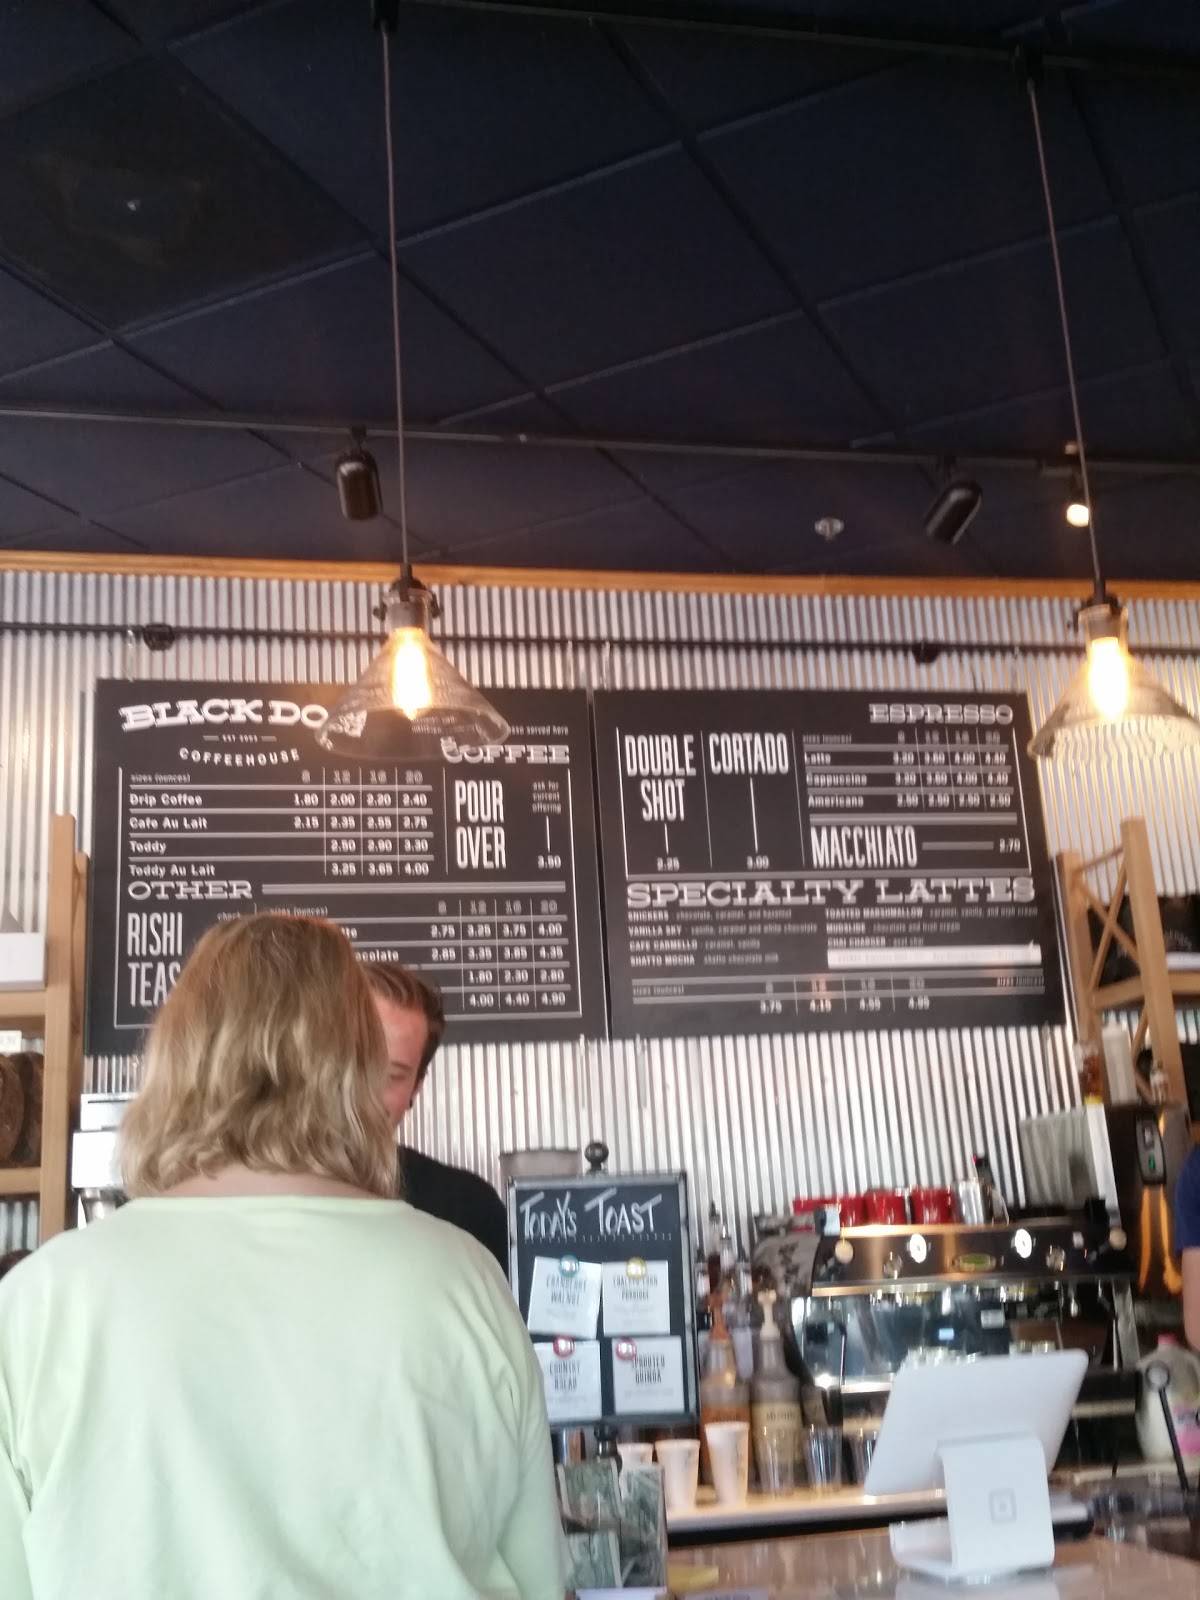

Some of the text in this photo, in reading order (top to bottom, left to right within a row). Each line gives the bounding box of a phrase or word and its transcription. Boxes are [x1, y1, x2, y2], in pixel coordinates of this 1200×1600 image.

[119, 699, 263, 731] BLACK
[869, 703, 1013, 723] ESPRESSO
[180, 747, 299, 766] COFFEEHOUSE
[440, 736, 570, 764] COFFEE
[625, 734, 696, 776] DOUBLE
[709, 732, 789, 774] CORTADO
[130, 793, 156, 807] Drip
[161, 793, 202, 806] Coffee
[455, 780, 504, 822] POUR
[641, 778, 685, 821] SHOT
[130, 816, 158, 829] Cafe
[163, 816, 179, 829] Au
[183, 816, 208, 829] Lait
[130, 840, 166, 854] Toddy
[456, 827, 506, 869] OVER
[811, 825, 917, 868] MACCHIATO
[130, 864, 166, 878] Toddy
[171, 864, 187, 877] Au
[191, 864, 215, 877] Lait
[128, 880, 252, 900] OTHER
[628, 877, 1035, 908] SPECIALTY LATTES
[128, 912, 182, 957] RISHI
[584, 1187, 663, 1235] TOAST
